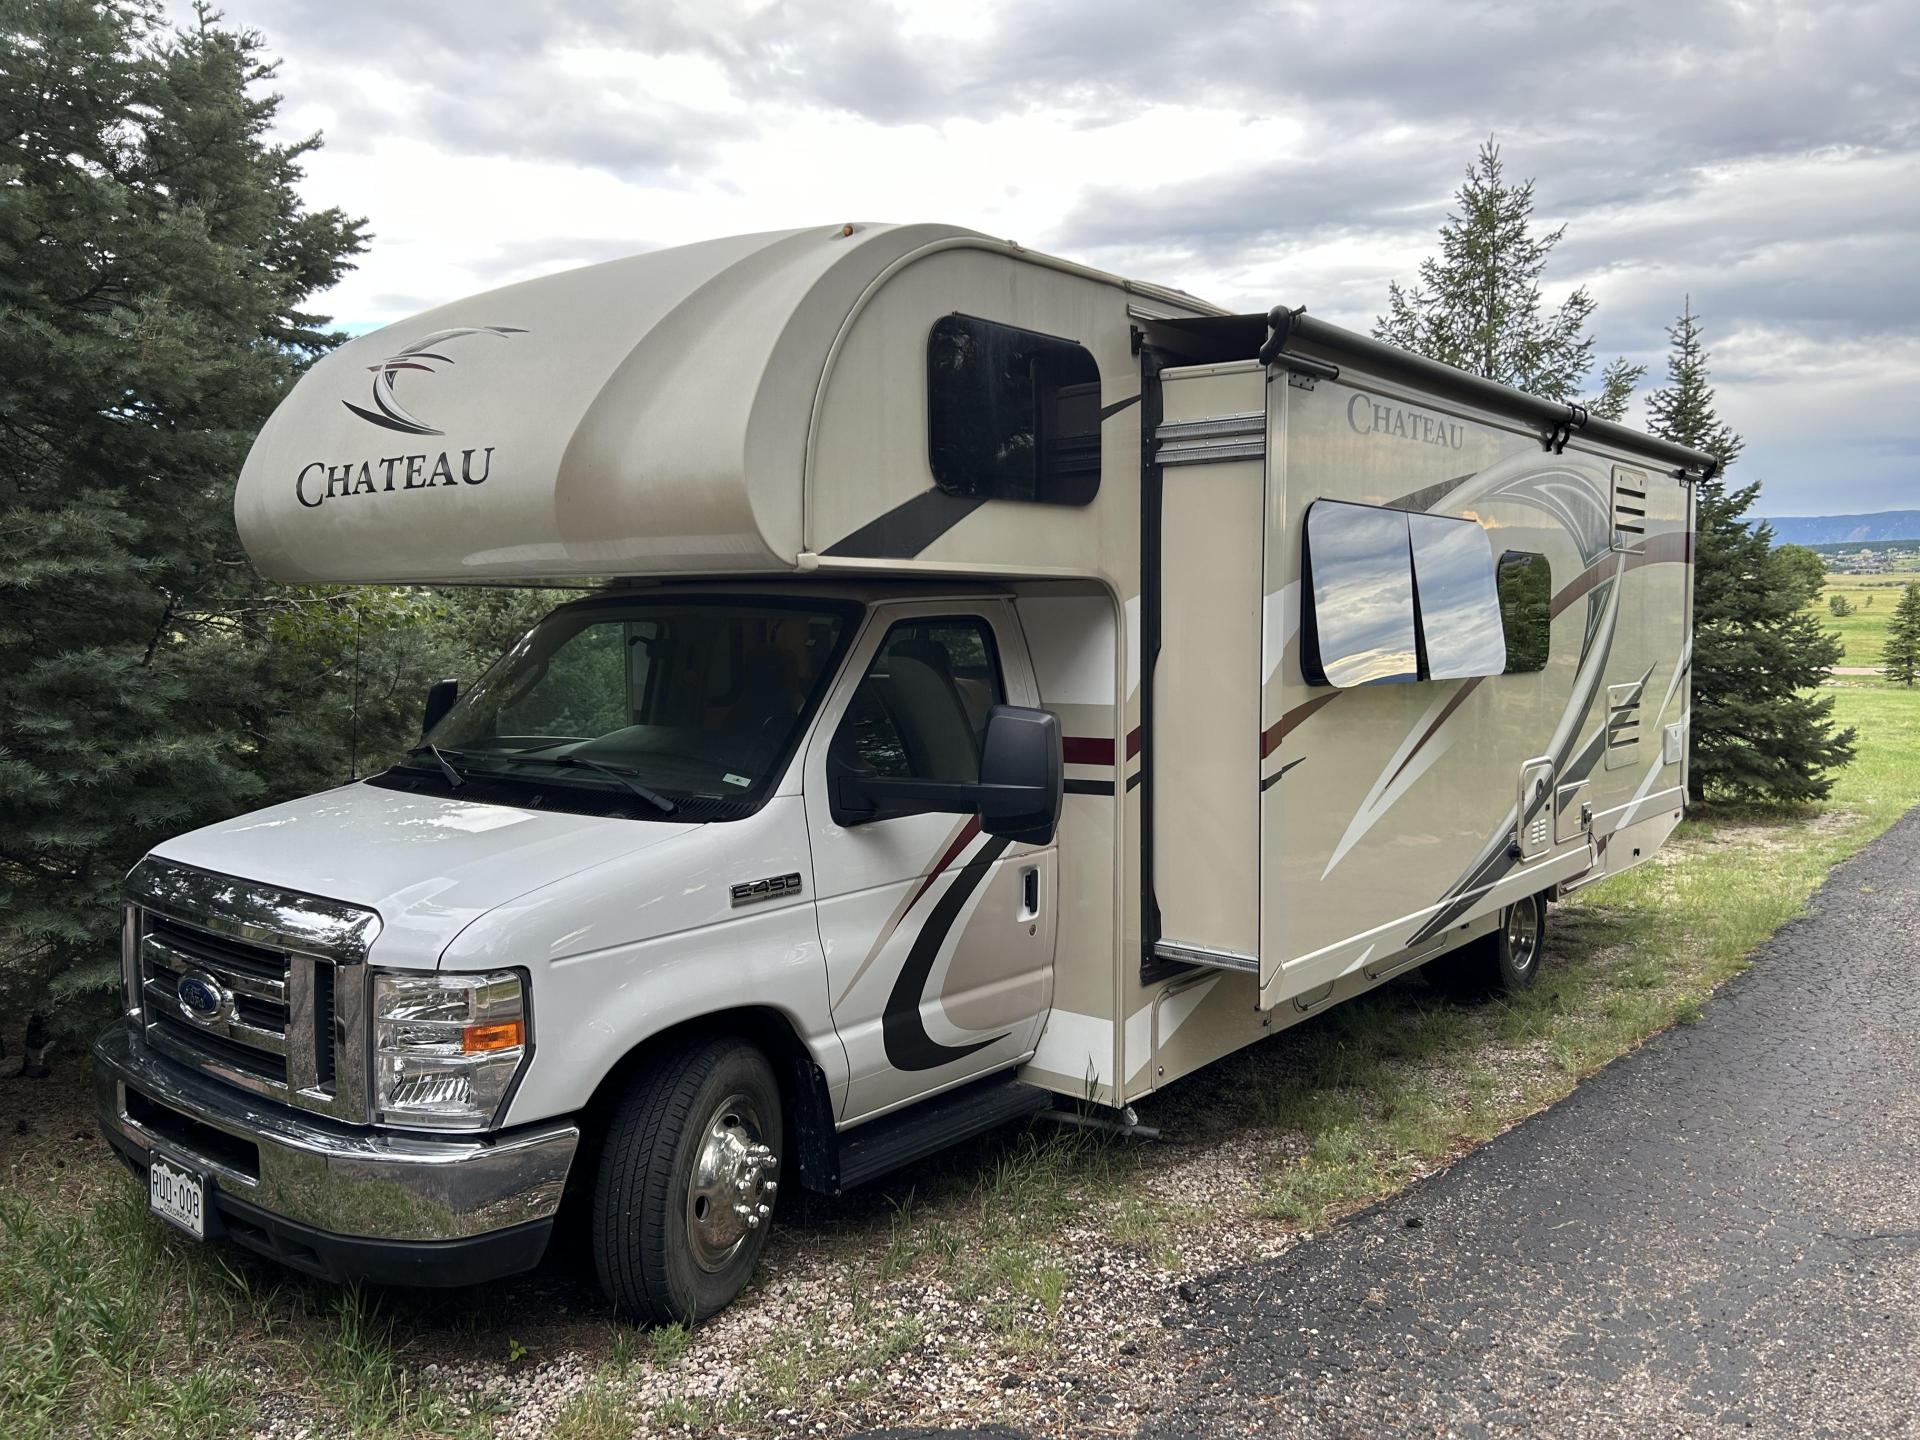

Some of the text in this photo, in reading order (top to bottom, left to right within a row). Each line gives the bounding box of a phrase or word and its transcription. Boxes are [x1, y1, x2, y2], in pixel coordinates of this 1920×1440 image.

[1347, 393, 1464, 450] CHATEAU
[296, 447, 495, 508] CHATEAU
[732, 873, 801, 899] E-450
[164, 1203, 191, 1223] COLORADO
